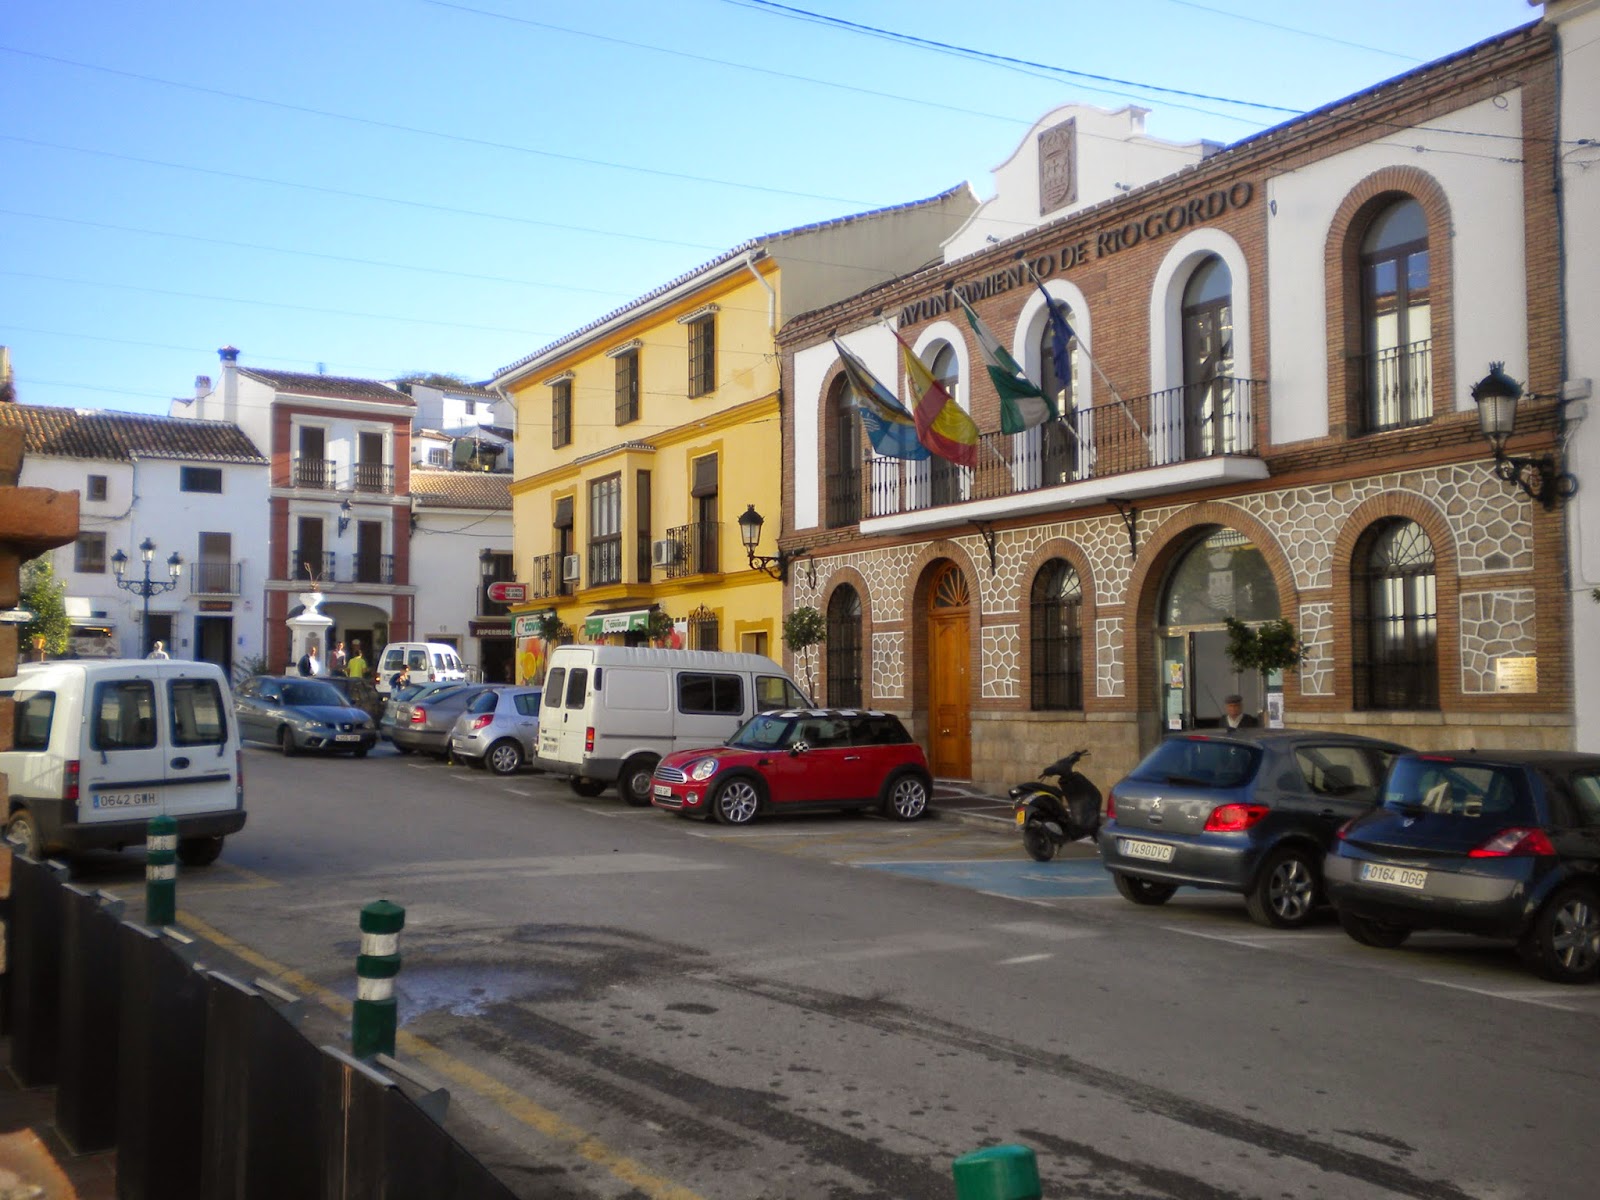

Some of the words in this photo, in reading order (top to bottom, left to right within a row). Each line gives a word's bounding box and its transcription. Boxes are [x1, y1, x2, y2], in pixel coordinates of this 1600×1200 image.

[899, 253, 1054, 328] AYUNTAMIENTO
[1060, 239, 1088, 272] DE
[1096, 181, 1254, 259] RIOGORDO
[100, 794, 131, 807] 0642
[1370, 866, 1395, 881] 0164
[1401, 870, 1424, 886] DGG
